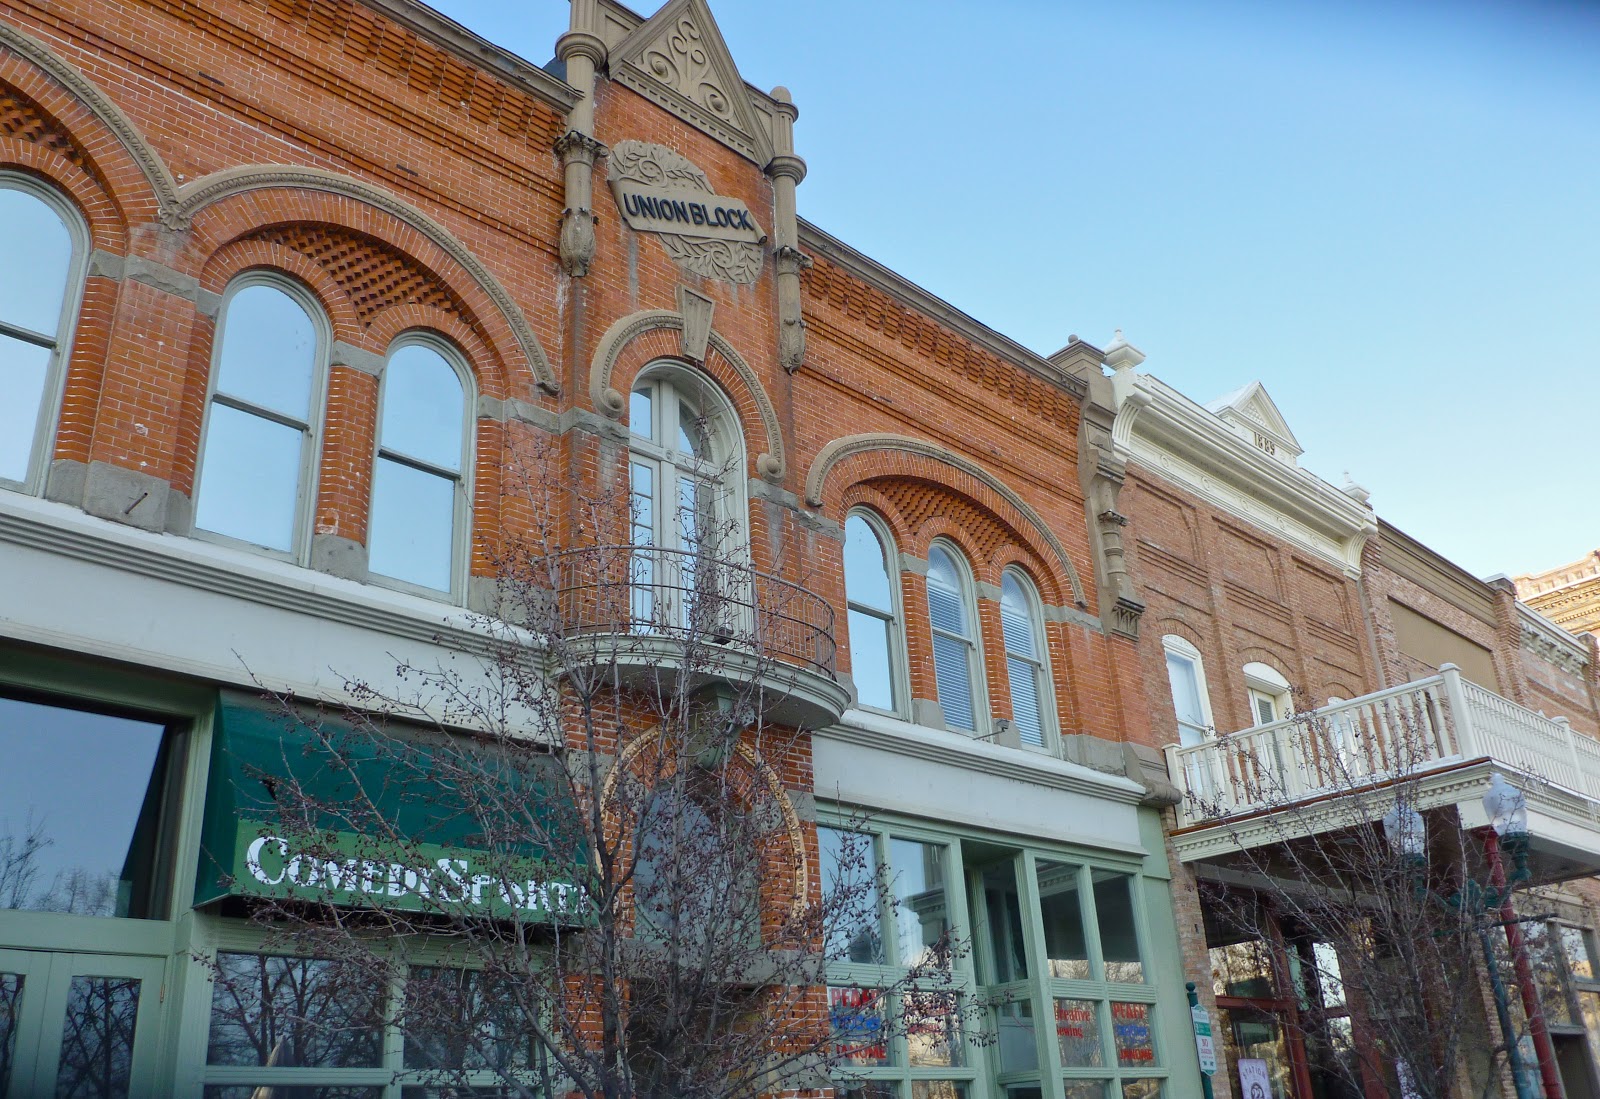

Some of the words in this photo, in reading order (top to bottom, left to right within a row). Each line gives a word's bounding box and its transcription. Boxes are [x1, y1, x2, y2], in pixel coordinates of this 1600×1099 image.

[623, 193, 690, 224] UNION
[689, 202, 755, 231] BLOCK
[1112, 1002, 1146, 1019] PFAFF
